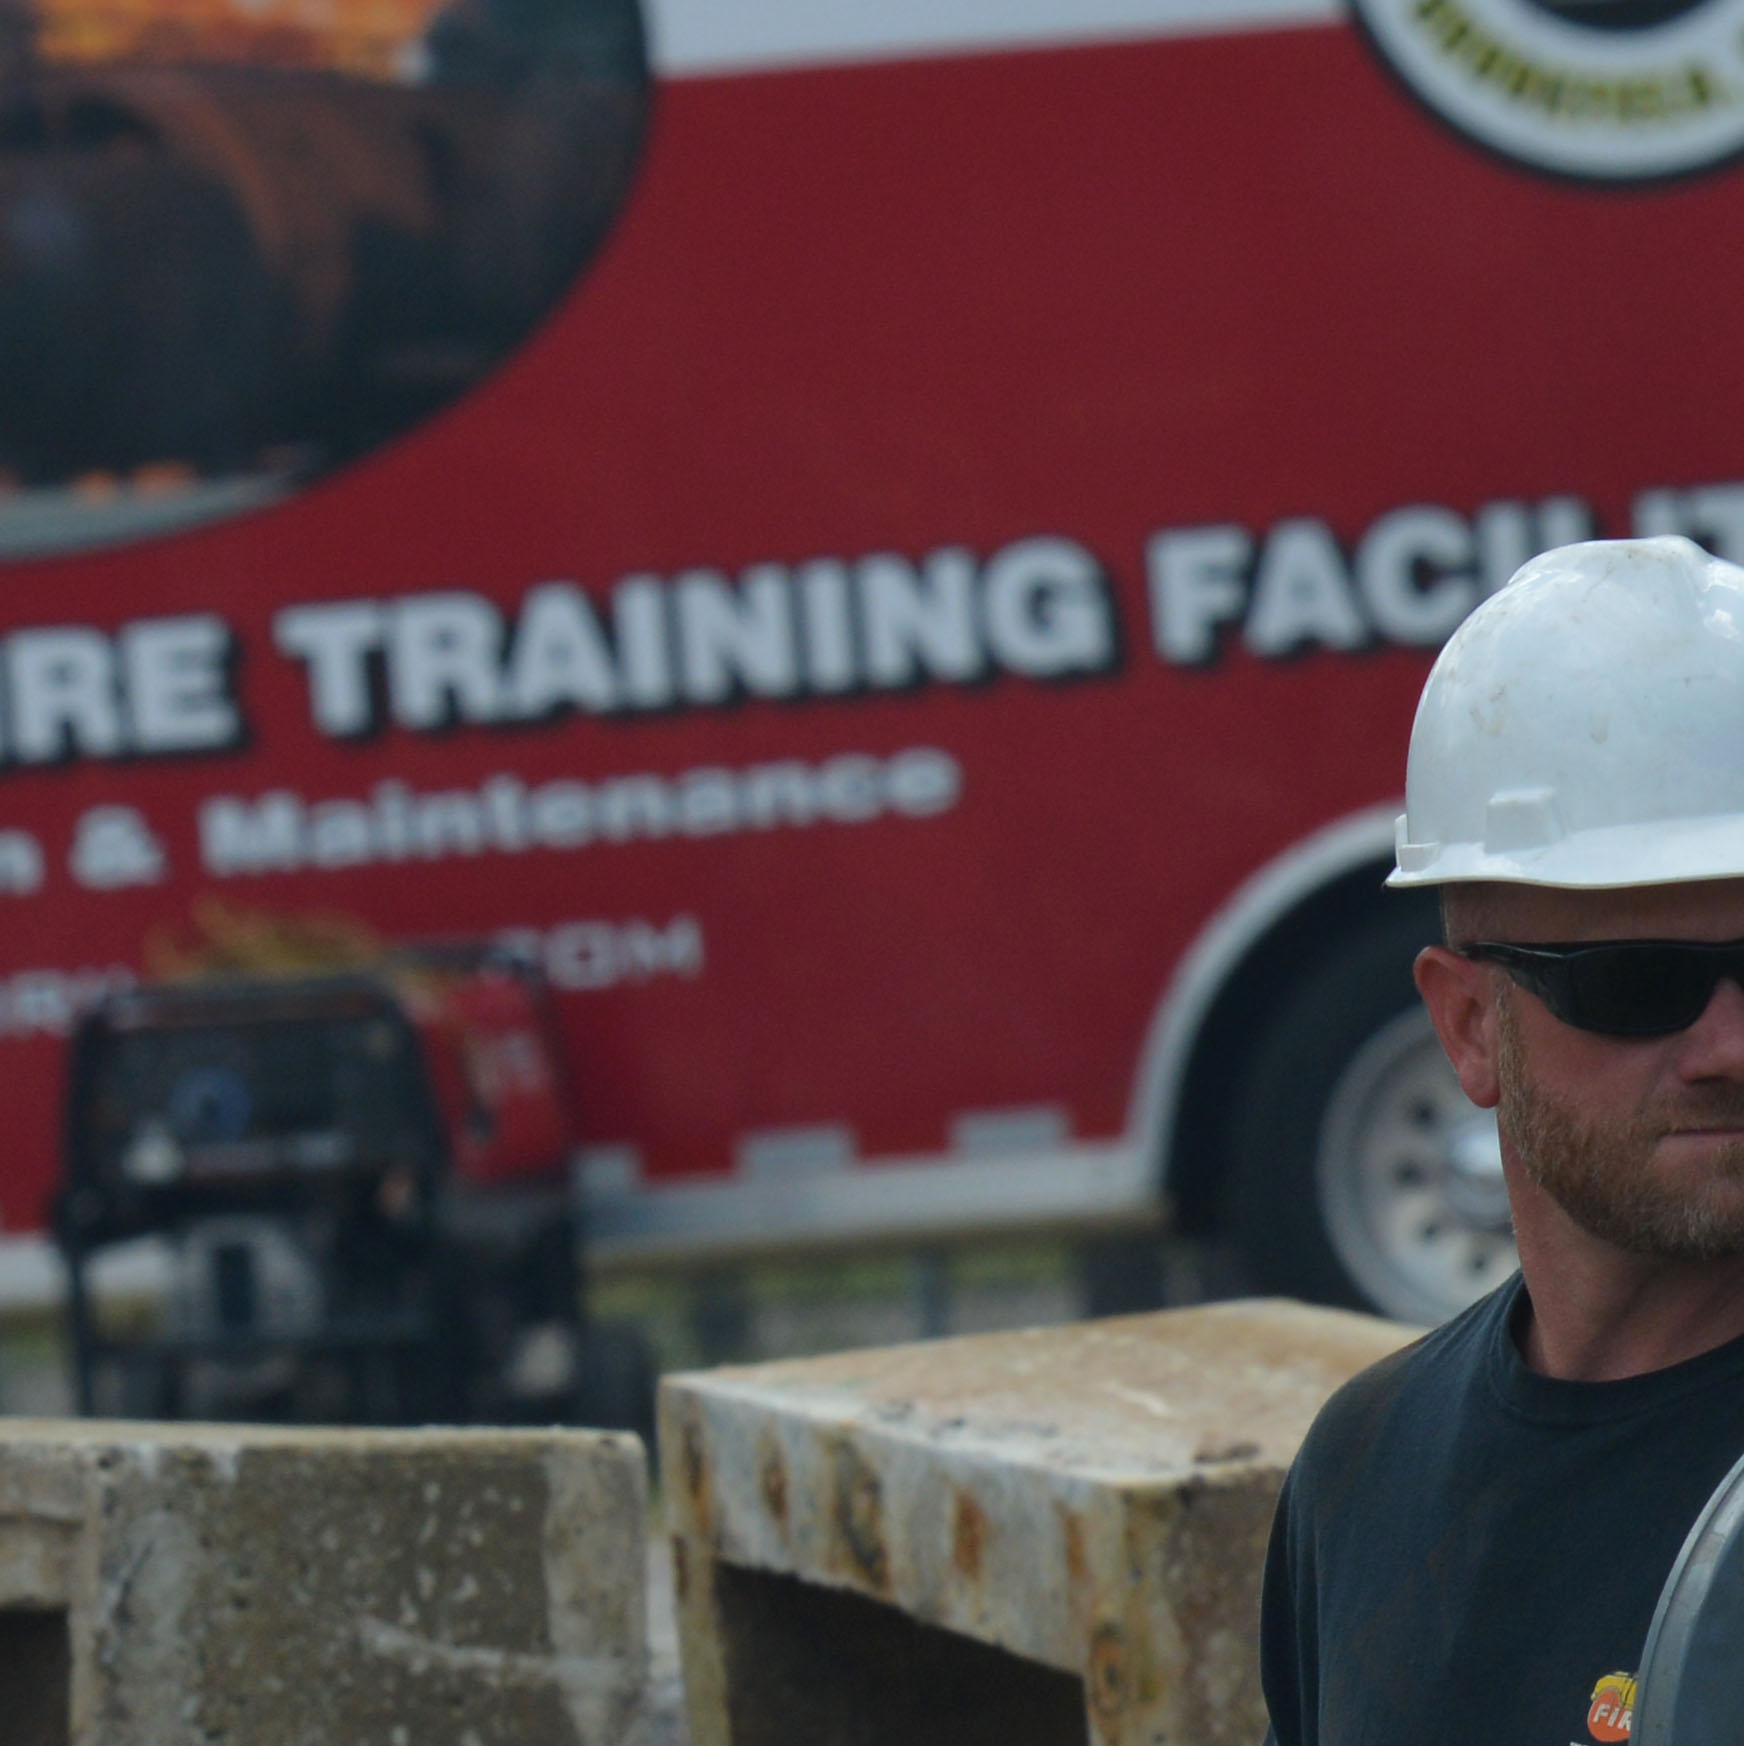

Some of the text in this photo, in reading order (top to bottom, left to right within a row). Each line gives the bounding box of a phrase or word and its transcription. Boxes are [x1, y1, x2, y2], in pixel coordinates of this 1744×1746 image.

[0, 613, 240, 764] RE
[274, 534, 1113, 740] TRAINING
[199, 746, 961, 878] Maintenance
